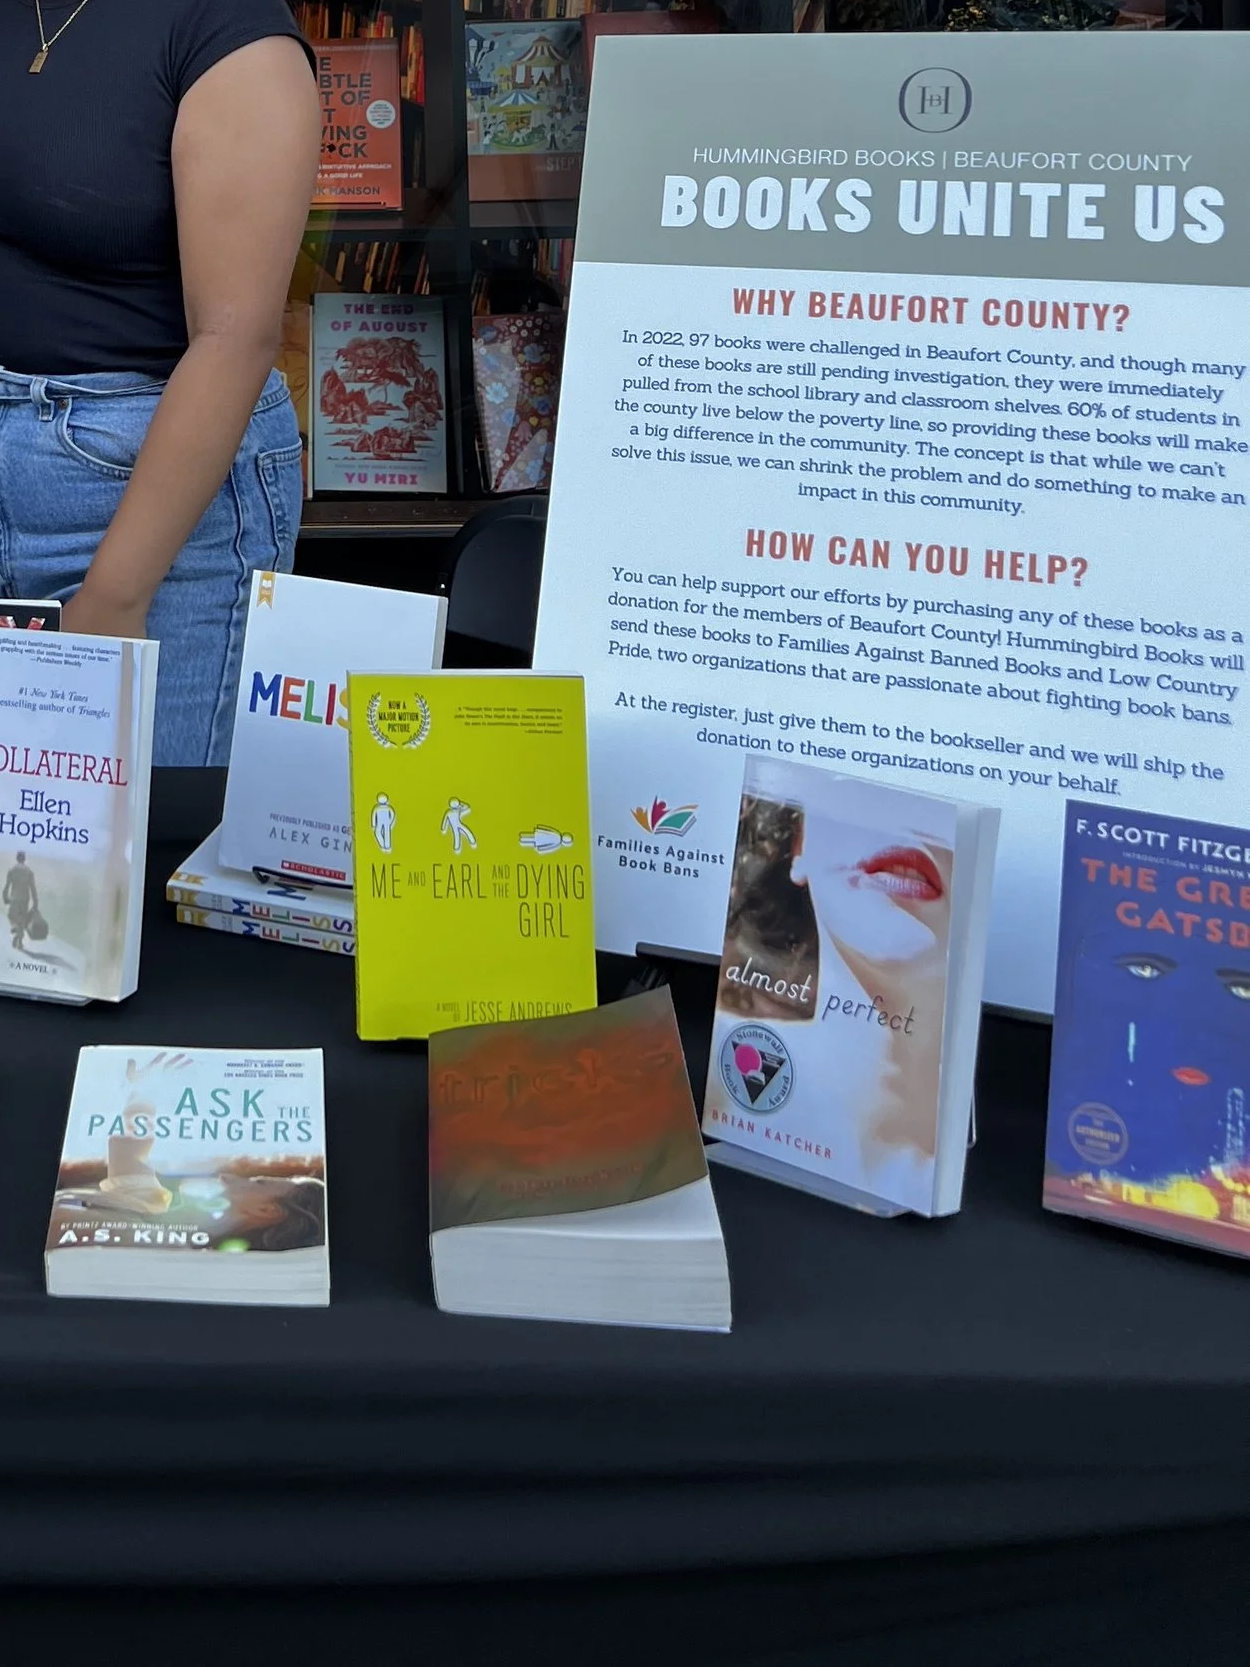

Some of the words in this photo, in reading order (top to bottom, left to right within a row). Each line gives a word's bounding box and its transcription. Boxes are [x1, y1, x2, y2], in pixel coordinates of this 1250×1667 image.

[319, 73, 372, 89] BTLE
[340, 90, 371, 106] OF
[693, 146, 848, 167] HUMMINGBIRD
[854, 149, 935, 168] BOOKS
[954, 152, 1081, 171] BEAUFORT
[1088, 153, 1192, 172] COUNTY
[333, 186, 381, 196] MANSON
[660, 174, 873, 235] BOOKS
[897, 179, 1106, 241] UNITE
[1133, 184, 1227, 245] US
[343, 302, 376, 316] THE
[380, 302, 414, 316] END
[732, 286, 796, 318] WHY
[808, 291, 969, 326] BEAUFORT
[981, 299, 1131, 333] COUNTY?
[330, 320, 355, 333] OF
[359, 320, 428, 333] AUGUST
[622, 329, 638, 344] In
[689, 333, 710, 348] 97
[714, 335, 761, 350] books
[766, 339, 805, 353] were
[810, 339, 900, 359] challenged
[905, 343, 921, 358] in
[926, 345, 1002, 363] Beaufort
[1006, 348, 1076, 369] County,
[1080, 353, 1115, 369] and
[1120, 355, 1186, 374] though
[1191, 361, 1247, 380] many
[344, 472, 370, 485] YU
[374, 472, 418, 486] MIRI
[745, 528, 815, 563] HOW
[827, 536, 891, 570] CAN
[905, 542, 969, 577] YOU
[983, 551, 1089, 588] HELP?
[249, 670, 350, 730] MELI
[19, 789, 72, 817] Ellen
[269, 826, 310, 845] ALEX
[1076, 818, 1092, 835] F.
[1097, 822, 1170, 849] SCOTT
[597, 835, 660, 859] Families
[666, 843, 726, 867] Against
[371, 863, 402, 899] ME
[407, 870, 427, 887] AND
[432, 863, 487, 899] EARL
[491, 865, 510, 879] AND
[515, 863, 585, 899] DYING
[618, 853, 659, 875] Book
[663, 860, 701, 880] Bans
[1080, 857, 1158, 894] THE
[492, 882, 510, 898] THE
[518, 902, 570, 939] GIRL
[1116, 901, 1250, 949] GATSB
[725, 956, 813, 1004] almost
[821, 994, 915, 1035] perfect
[464, 1001, 503, 1023] JESSE
[509, 1000, 572, 1022] ANDREWS
[174, 1087, 265, 1119] ASK
[278, 1106, 311, 1119] THE
[87, 1113, 313, 1143] PASSENGERS
[711, 1109, 756, 1134] BRIAN
[764, 1126, 832, 1160] KATCHER
[58, 1228, 121, 1246] A.S.
[133, 1229, 210, 1246] KING
